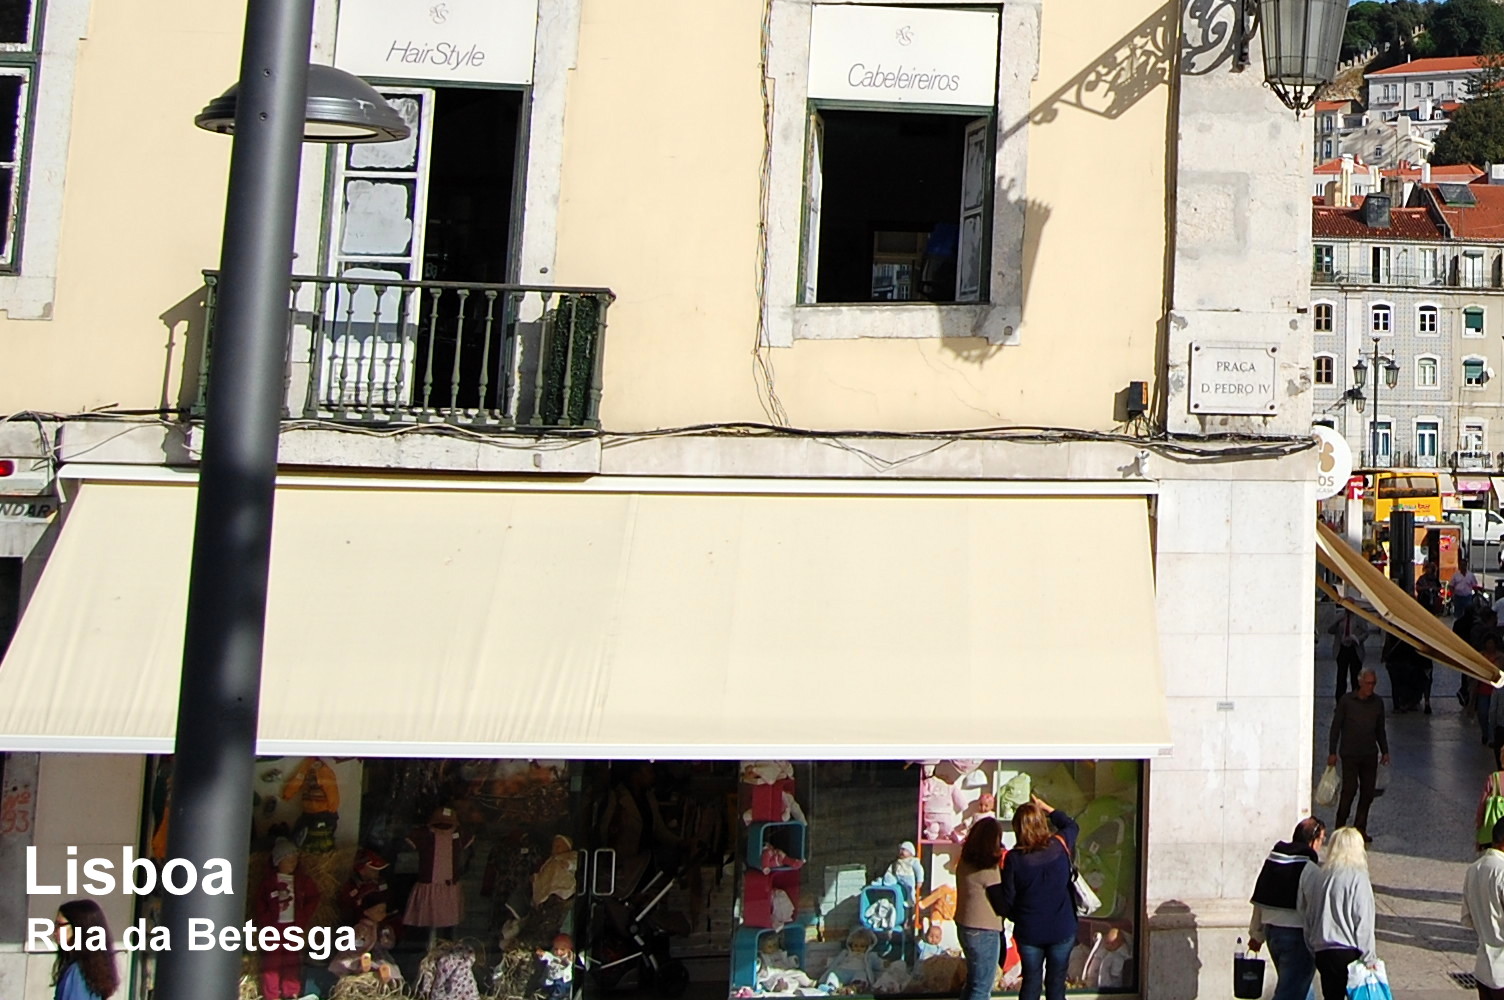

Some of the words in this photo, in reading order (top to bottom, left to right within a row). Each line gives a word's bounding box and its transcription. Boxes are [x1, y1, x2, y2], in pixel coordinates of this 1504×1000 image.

[386, 40, 485, 70] HairStyle
[848, 63, 960, 91] Cabeleireiros
[1201, 383, 1212, 393] D.
[1214, 383, 1254, 395] PEDRO
[1258, 384, 1271, 394] IV
